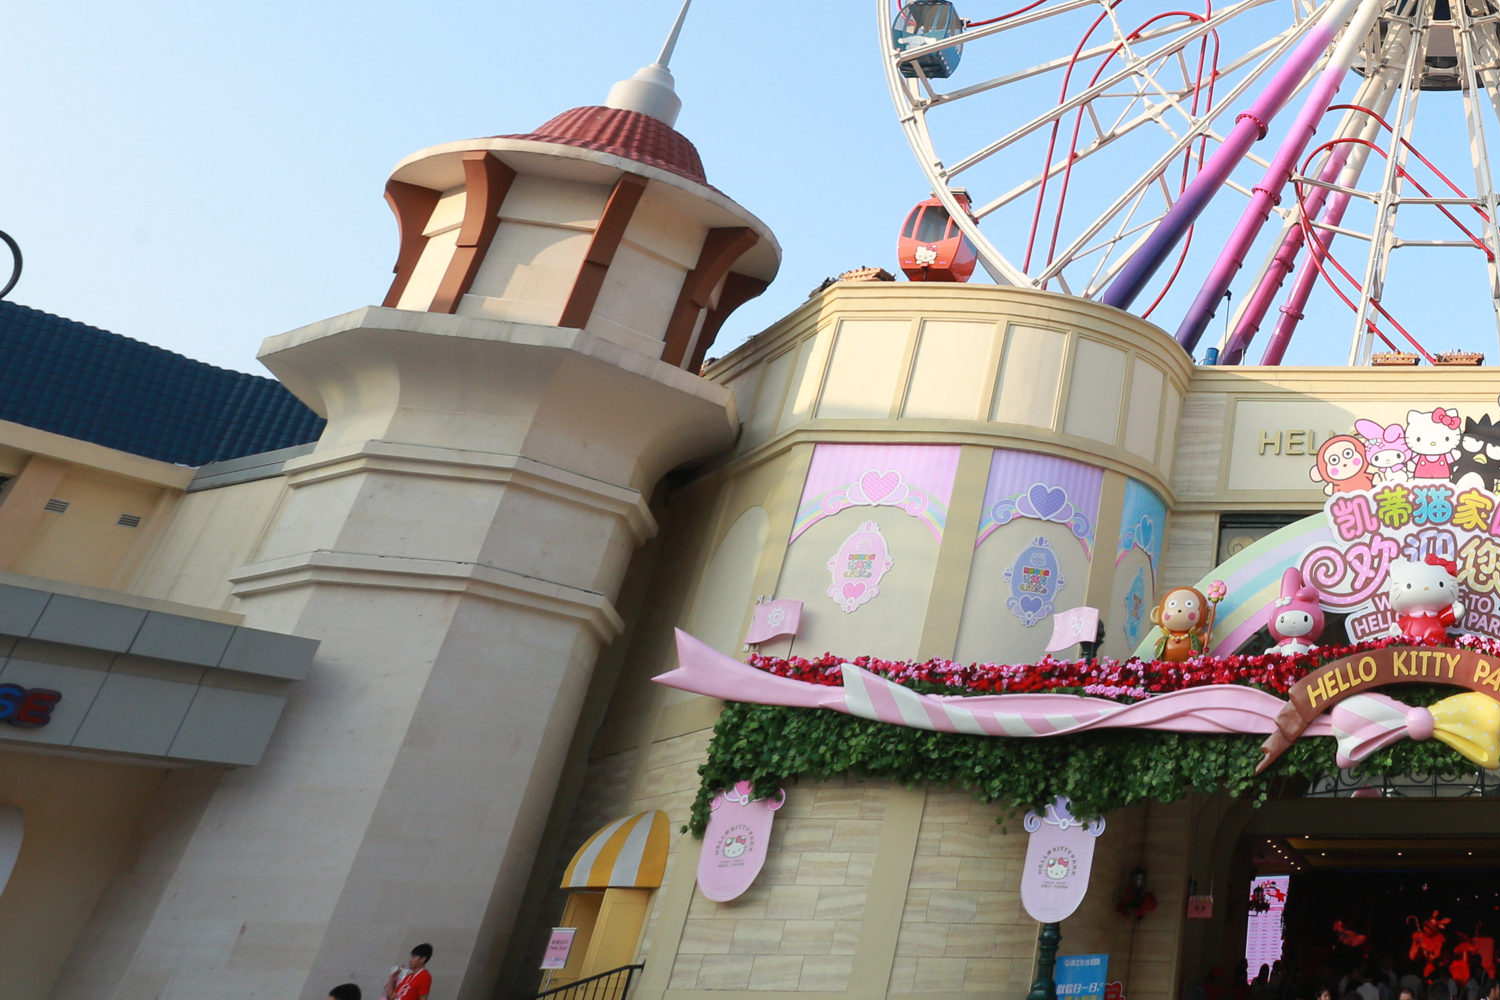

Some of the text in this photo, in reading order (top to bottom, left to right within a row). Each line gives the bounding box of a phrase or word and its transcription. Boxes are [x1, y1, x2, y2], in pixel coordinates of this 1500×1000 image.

[1259, 429, 1359, 456] HEL
[1469, 594, 1492, 615] TO
[1353, 612, 1401, 638] HELL
[1306, 656, 1377, 708] HELLO
[1393, 651, 1462, 678] KITTY
[730, 824, 750, 832] KITTY
[1052, 846, 1072, 855] KITTY
